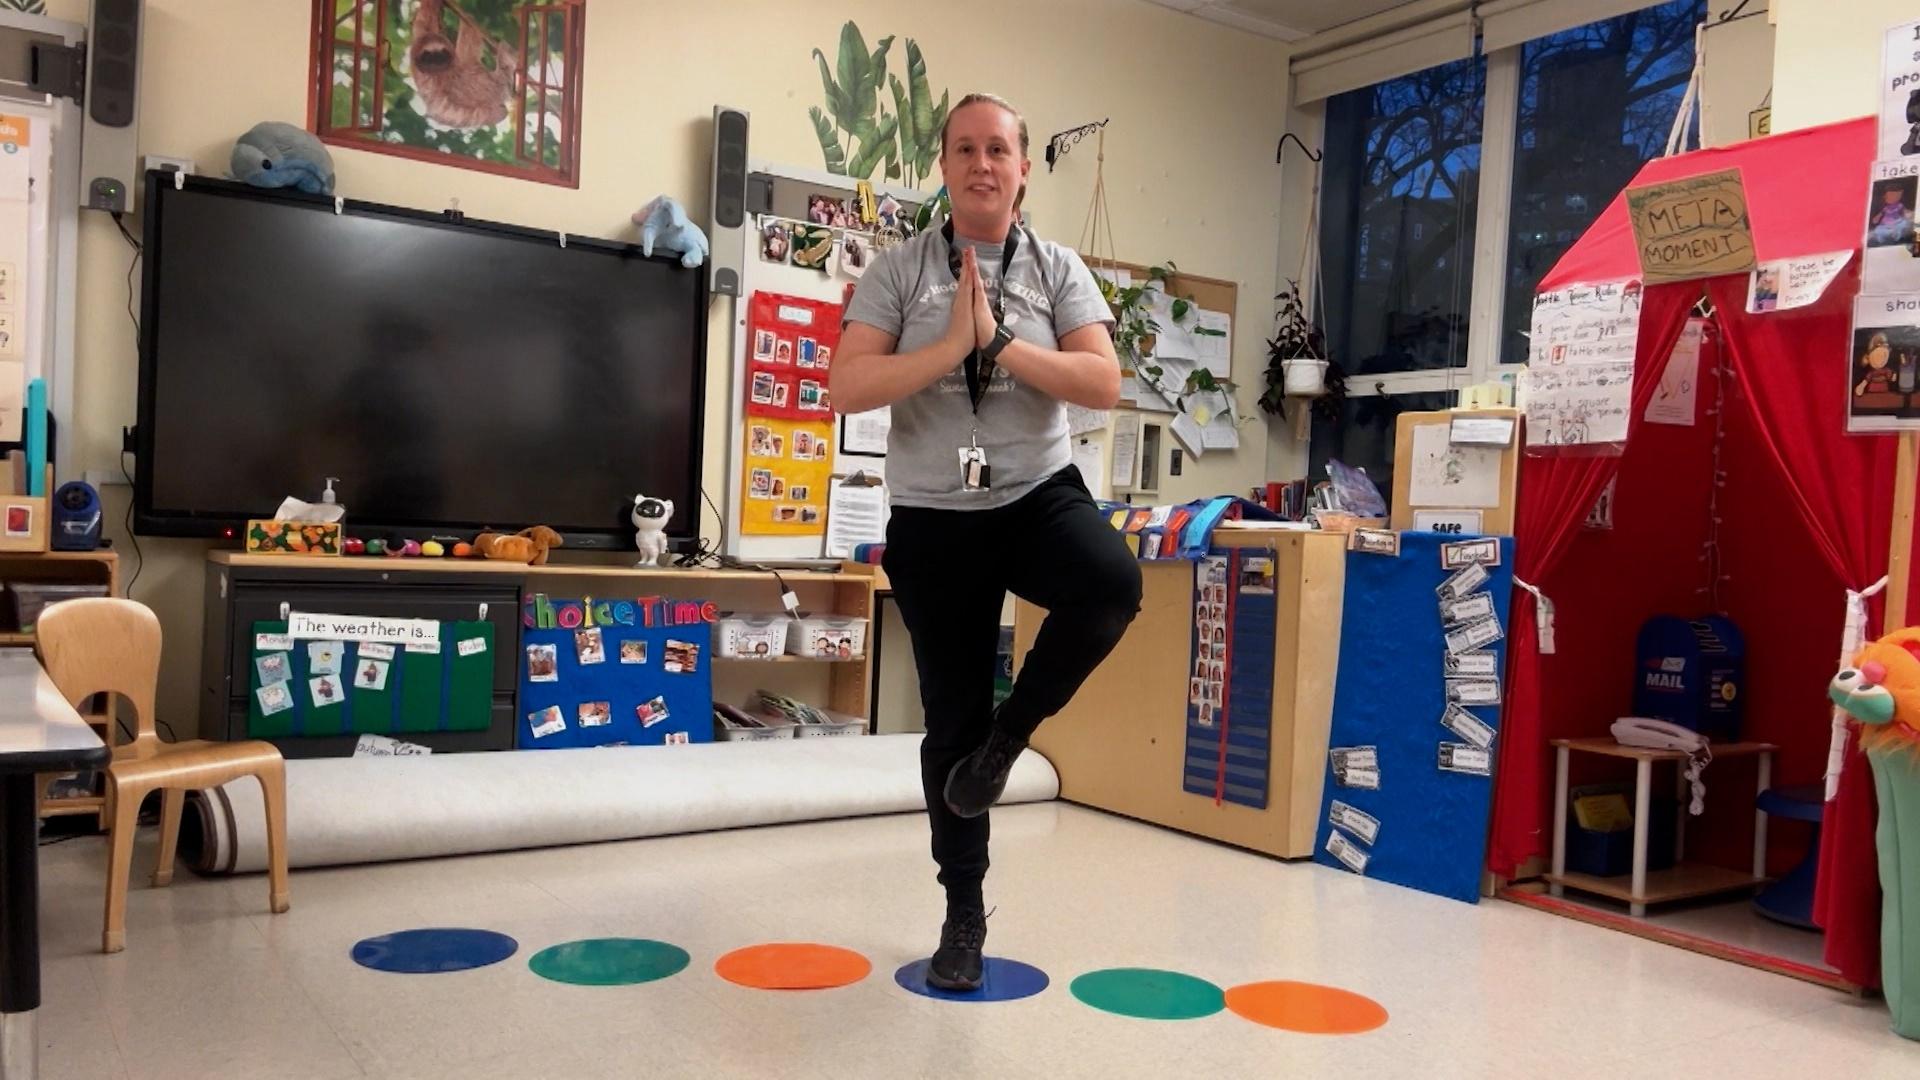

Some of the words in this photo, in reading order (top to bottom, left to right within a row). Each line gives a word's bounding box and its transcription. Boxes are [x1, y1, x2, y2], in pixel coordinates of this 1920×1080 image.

[1881, 164, 1919, 178] take
[1648, 197, 1737, 234] META
[1643, 233, 1735, 265] MOMENT
[637, 595, 720, 628] Time
[296, 616, 327, 634] The
[332, 621, 406, 637] weather
[410, 623, 436, 640] is...
[1646, 673, 1685, 689] MAIL
